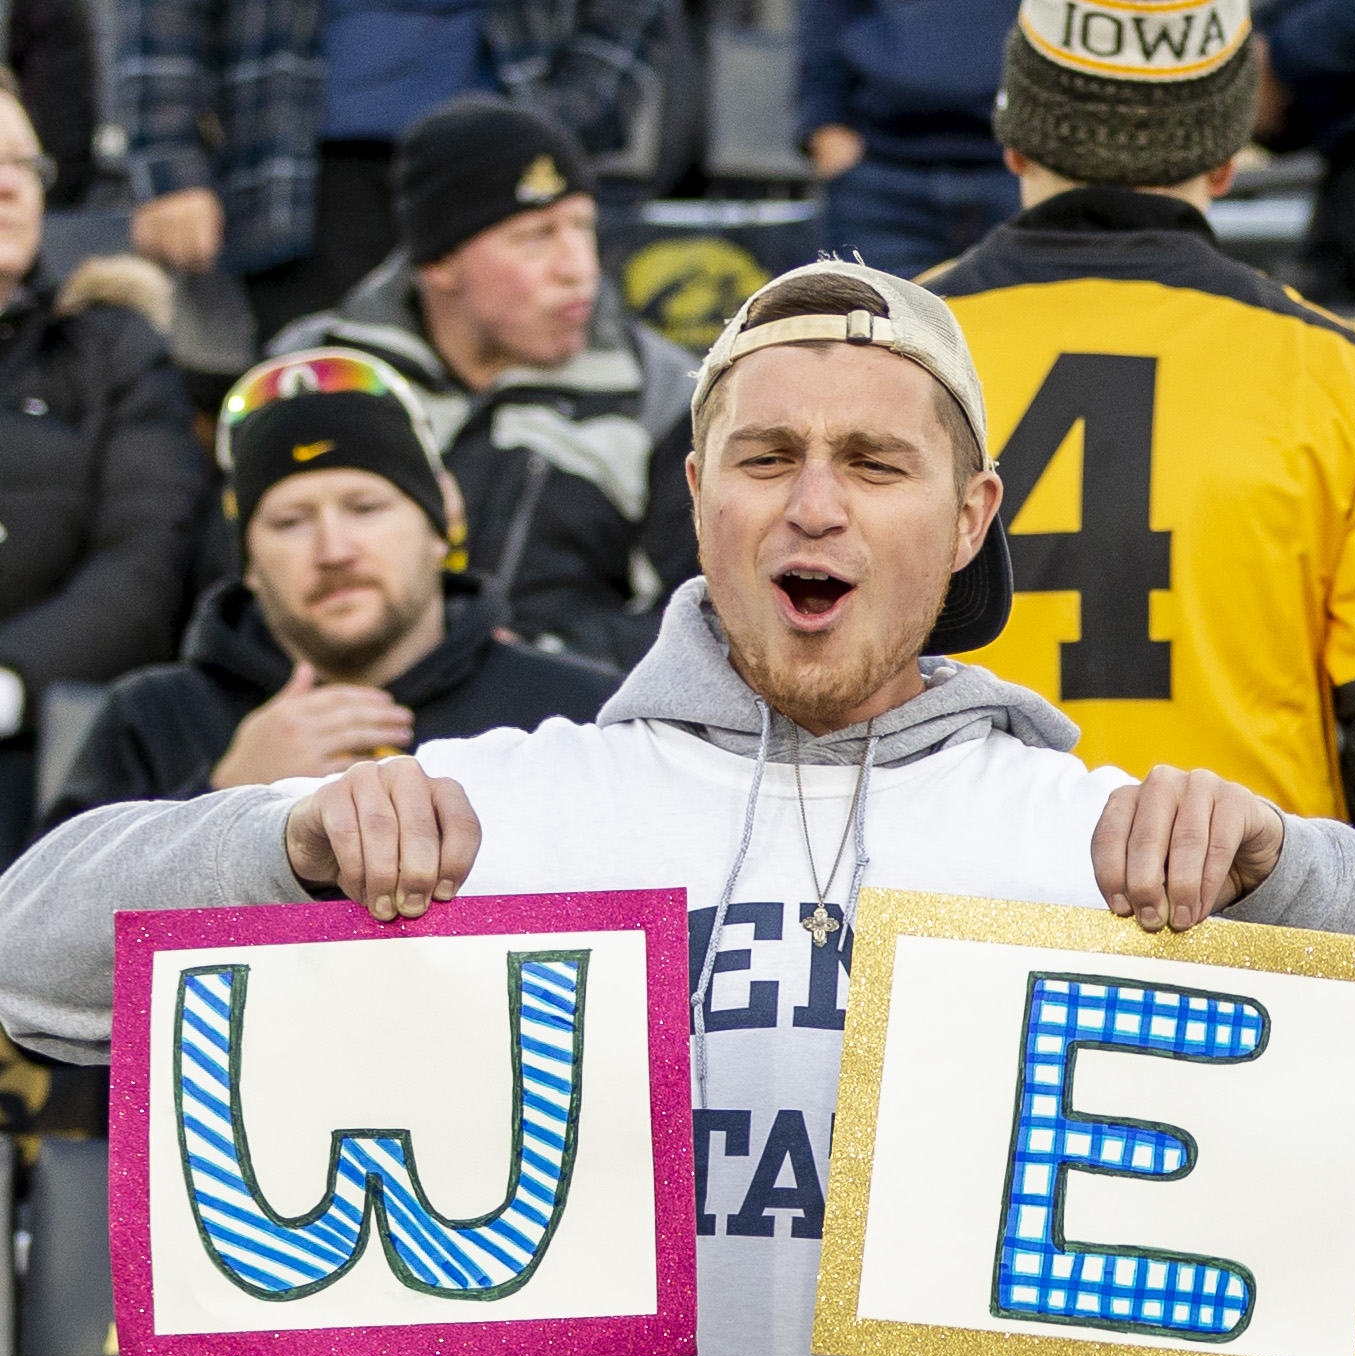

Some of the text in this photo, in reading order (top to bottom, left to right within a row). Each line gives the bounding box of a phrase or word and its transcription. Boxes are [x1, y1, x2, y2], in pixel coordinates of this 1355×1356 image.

[1062, 2, 1226, 62] IOWA
[995, 352, 1172, 701] 4
[174, 949, 592, 1303] W
[990, 971, 1271, 1344] E
